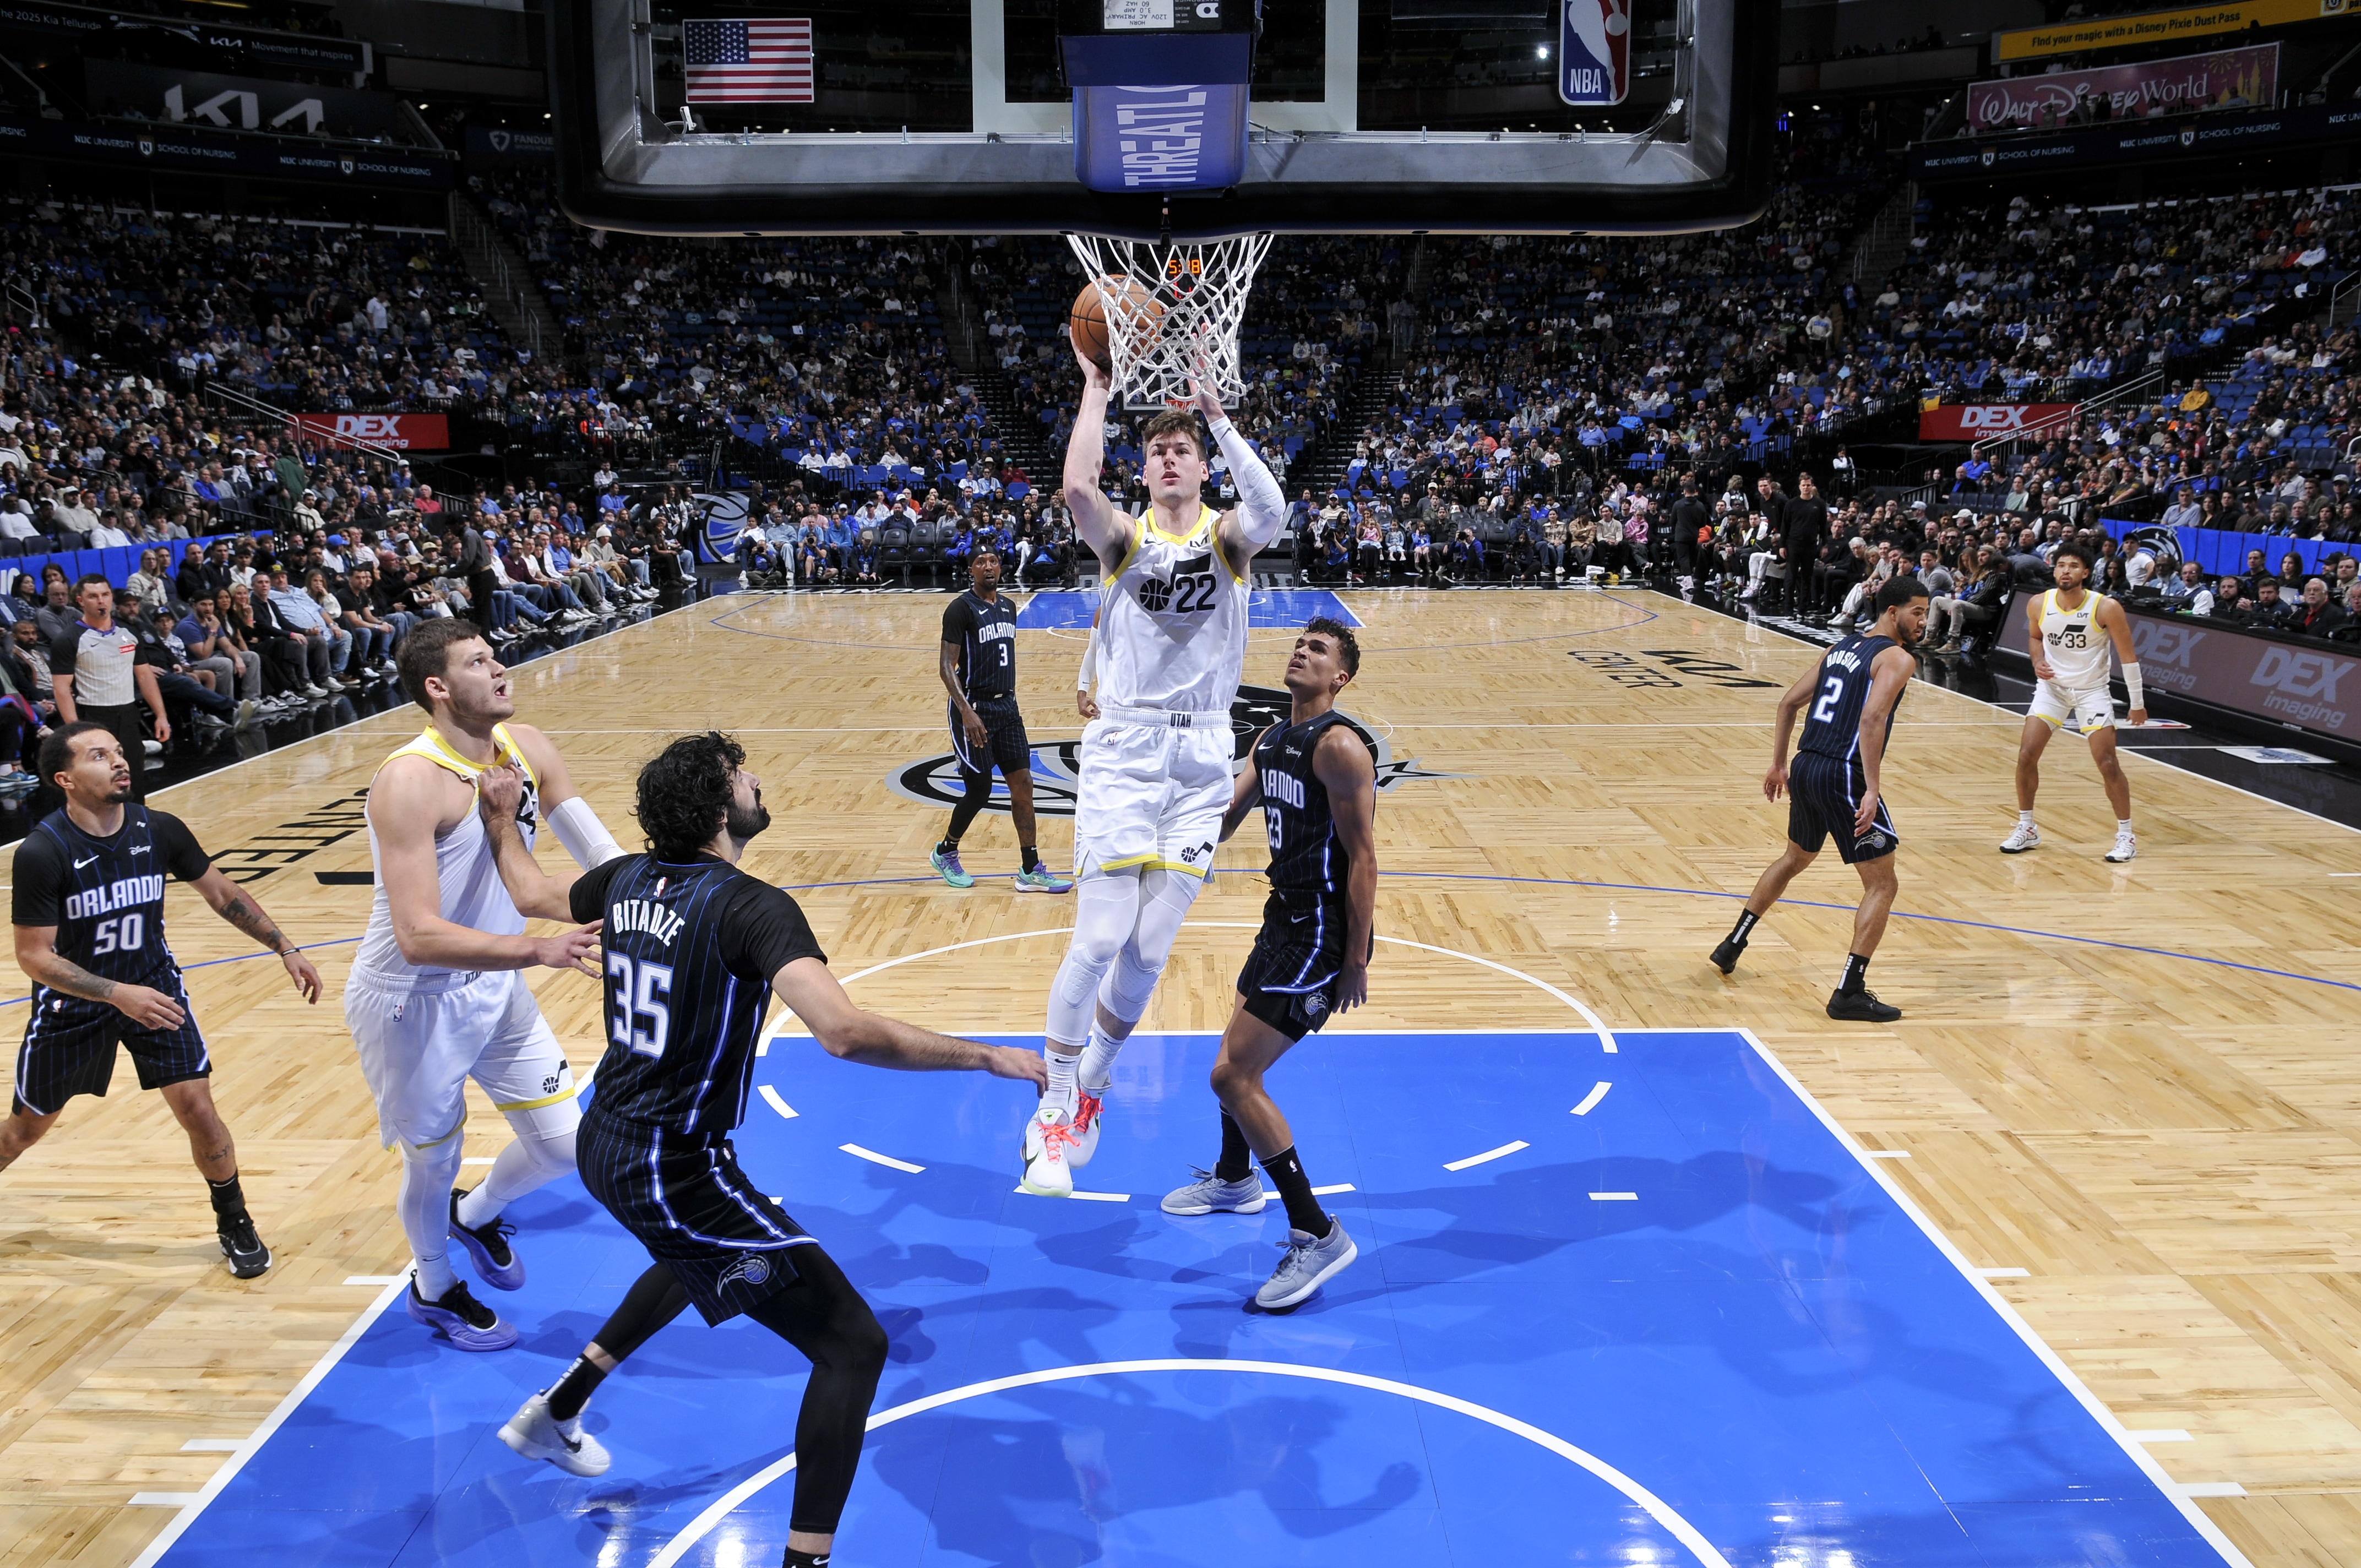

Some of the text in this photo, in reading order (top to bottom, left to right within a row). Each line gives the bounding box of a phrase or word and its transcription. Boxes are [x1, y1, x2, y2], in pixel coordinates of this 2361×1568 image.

[1, 9, 102, 30] he 2025 Kia Telluride
[2032, 12, 2240, 47] Find your magic with a Disney Pixie Dust Pass
[251, 40, 298, 56] Movement
[301, 46, 318, 57] that
[320, 48, 354, 62] inspires
[1569, 68, 1603, 94] NBA
[2141, 73, 2208, 105] World
[74, 134, 91, 145] NUC
[93, 138, 135, 149] UNIVERSITY
[157, 143, 189, 155] SCHOOL
[191, 147, 202, 156] OF
[203, 148, 237, 160] NURSING
[513, 134, 554, 145] FANDUE
[1116, 85, 1207, 186] THREATL
[2120, 139, 2136, 149] NUC
[2137, 134, 2177, 146] UNIVERSITY
[2199, 128, 2232, 139] SCHOOL
[2234, 126, 2244, 136] OF
[2245, 122, 2281, 134] NURSING
[280, 156, 298, 166] NUC
[299, 157, 336, 168] UNIVERSITY
[357, 162, 388, 173] SCHOOL
[389, 165, 399, 175] OF
[399, 166, 432, 177] NURSING
[1925, 158, 1940, 166] NUC
[1941, 154, 1978, 166] UNIVERSITY
[1998, 149, 2030, 160] SCHOOL
[2031, 148, 2041, 157] OF
[2042, 145, 2075, 156] NURSING
[1168, 259, 1200, 274] 5:8
[335, 415, 401, 438] DEX
[1959, 405, 2030, 428] DEX
[354, 437, 410, 449] maging
[1189, 533, 1210, 548] LVT
[1175, 574, 1217, 613] 22
[2065, 633, 2087, 649] 33
[2131, 620, 2207, 668] DEX
[999, 643, 1008, 667] 3
[1826, 650, 1862, 674] HOUSTAN
[1566, 650, 1684, 689] CENTER
[2138, 659, 2197, 690] maging
[2249, 646, 2357, 704] DEX
[1813, 675, 1843, 724] 2
[2263, 690, 2347, 729] imaging
[1170, 712, 1192, 728] UTAH
[1285, 744, 1302, 758] Disney
[1261, 767, 1305, 810] LANDO
[128, 845, 151, 856] Disney
[66, 874, 164, 921] ORLANDO
[93, 912, 144, 957] 50
[612, 899, 686, 948] BITADZE
[607, 950, 674, 1060] 35
